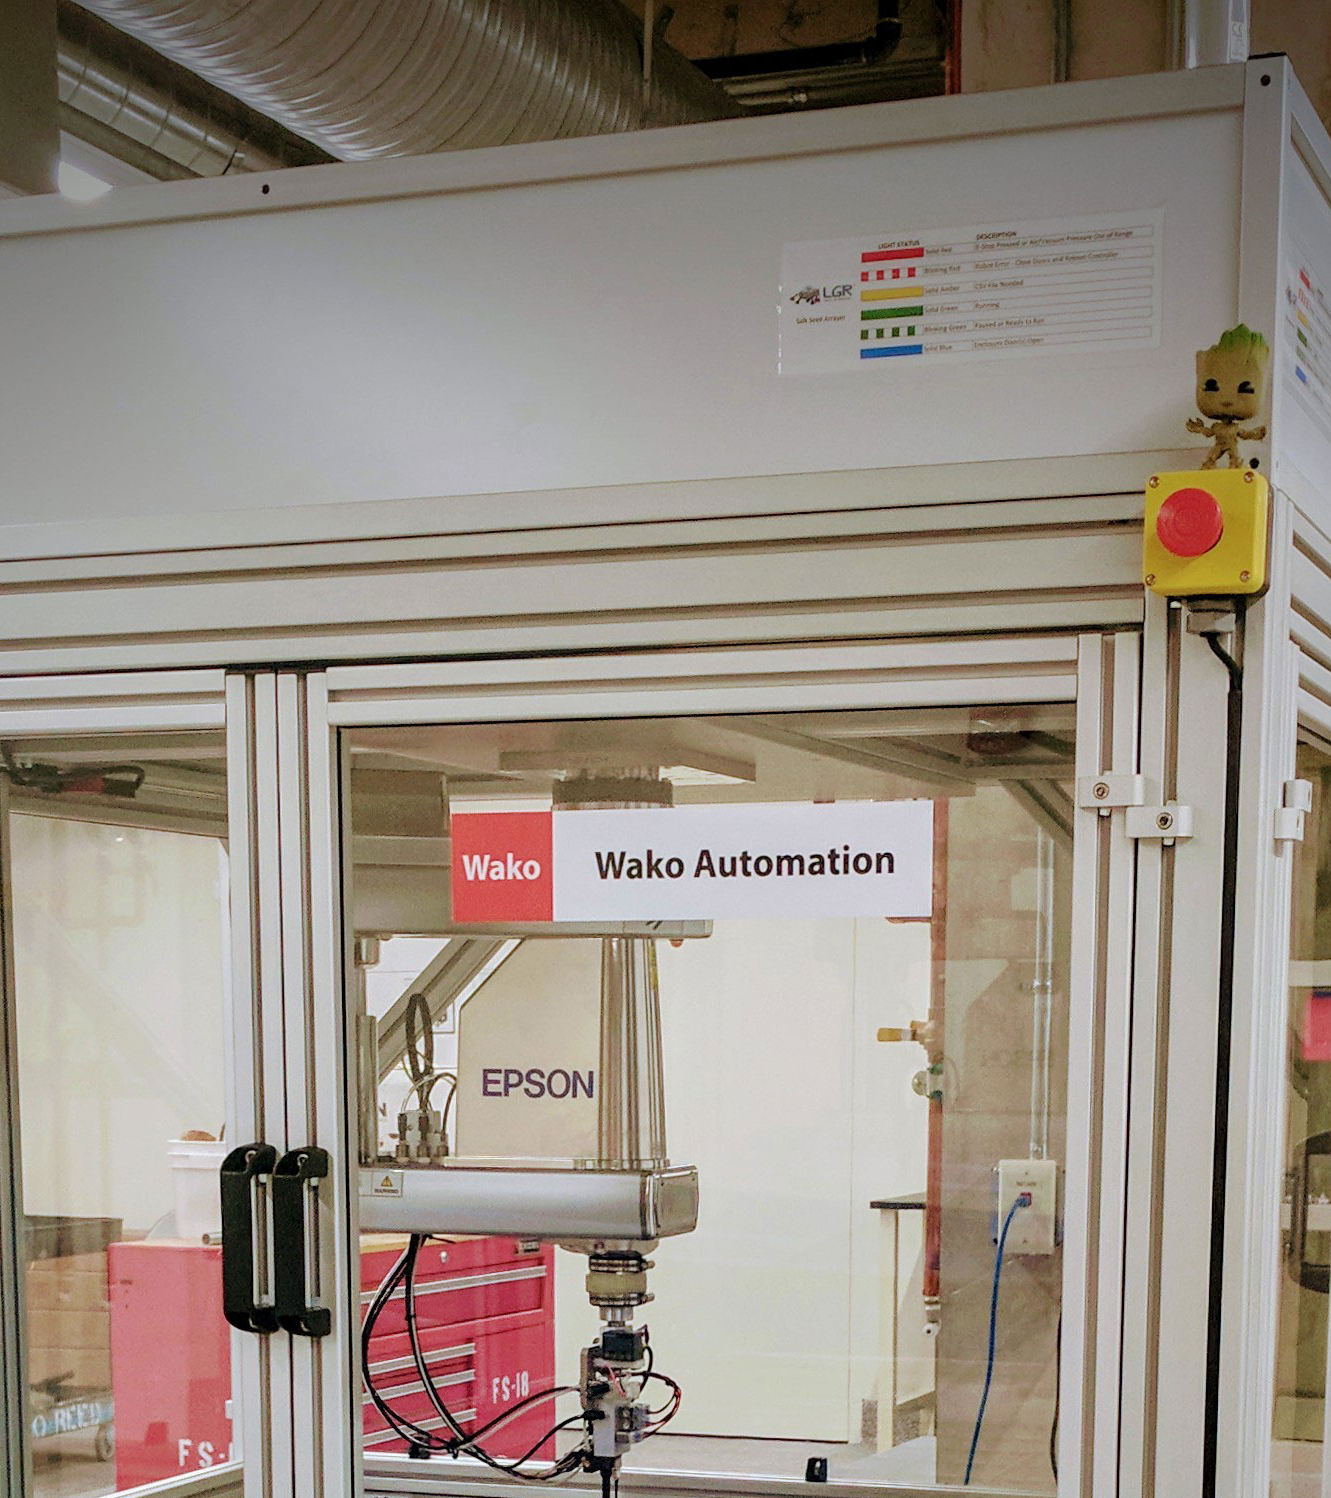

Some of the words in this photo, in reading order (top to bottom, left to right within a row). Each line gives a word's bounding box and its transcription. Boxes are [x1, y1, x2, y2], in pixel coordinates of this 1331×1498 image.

[823, 284, 853, 298] LGR
[461, 853, 541, 882] Wako
[595, 849, 685, 880] Wako
[694, 844, 895, 878] Automation
[481, 1068, 595, 1099] EPSON
[492, 1370, 529, 1405] FS-18
[54, 1402, 101, 1434] REED
